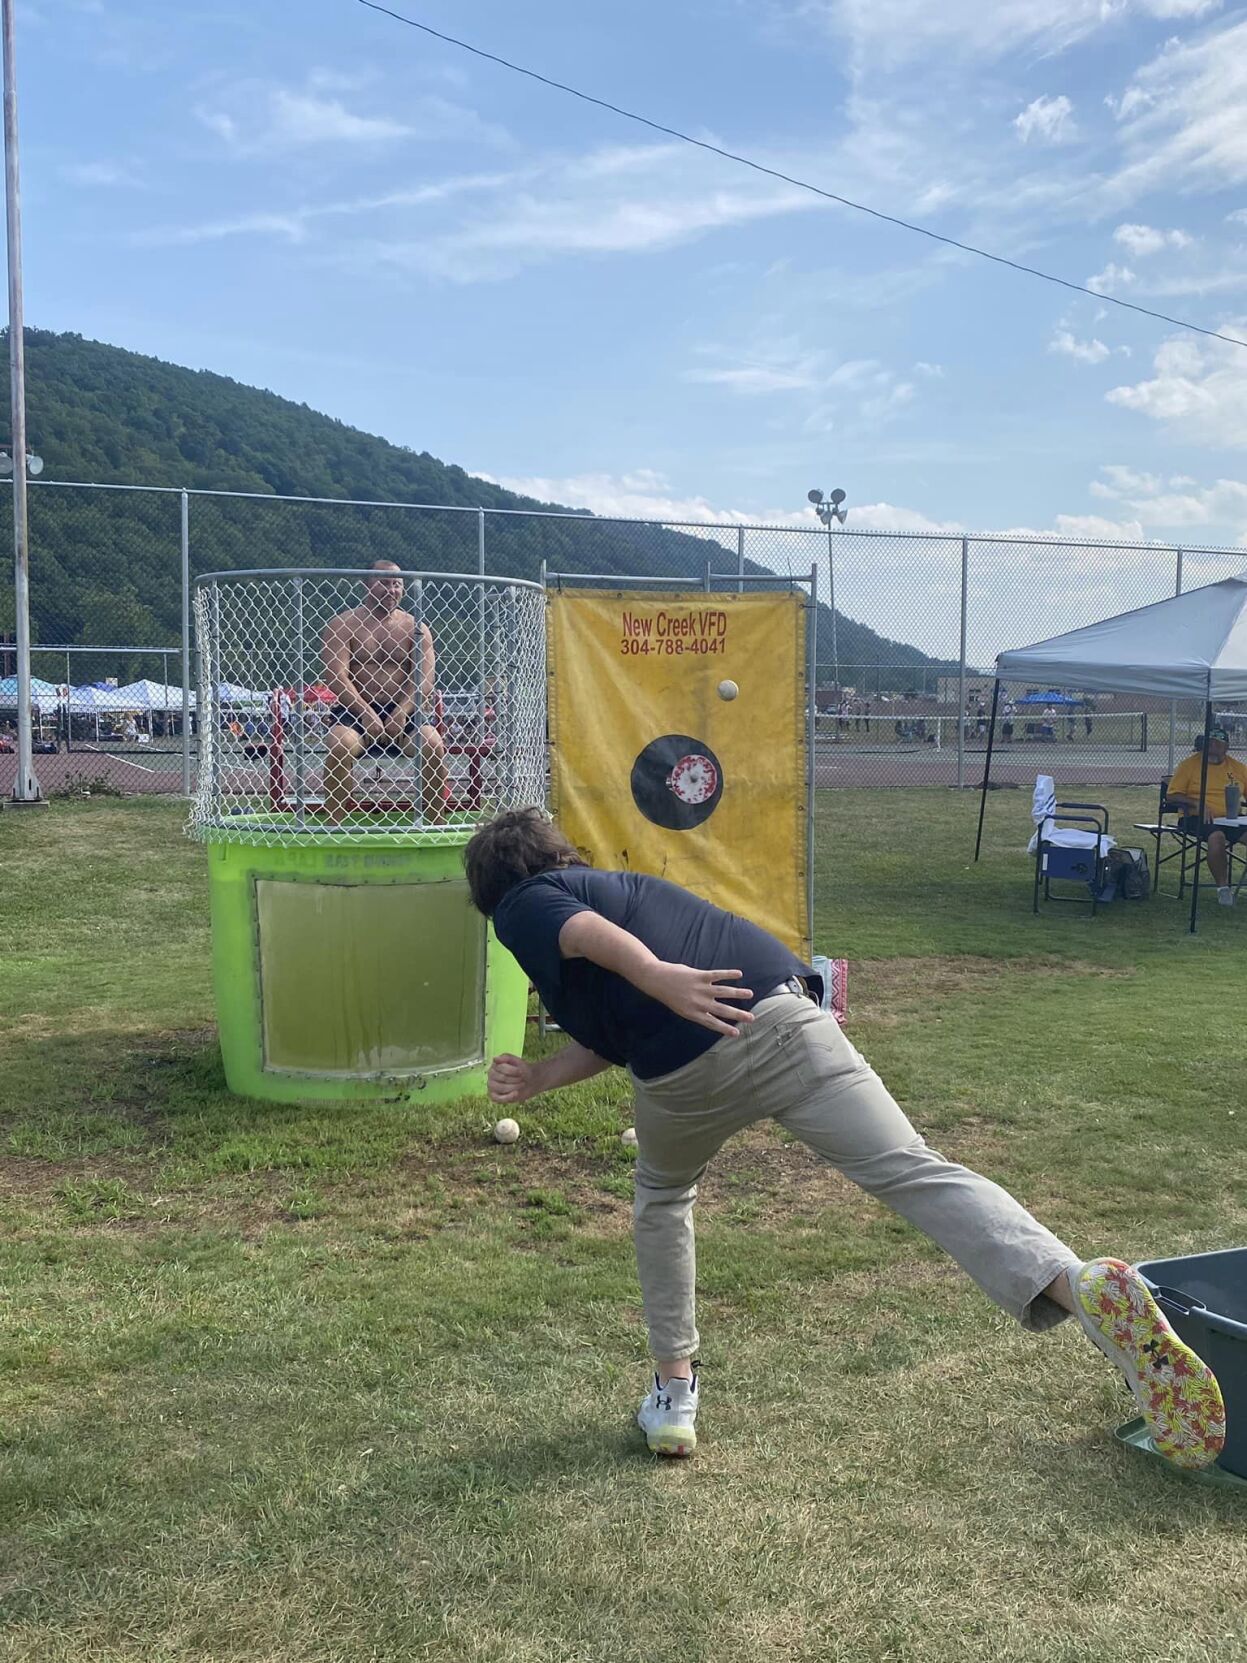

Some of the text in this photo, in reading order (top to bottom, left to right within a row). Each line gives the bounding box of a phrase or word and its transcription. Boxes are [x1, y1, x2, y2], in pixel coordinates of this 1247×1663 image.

[622, 611, 727, 637] New Creek VFD
[620, 638, 726, 655] 304-788-4041
